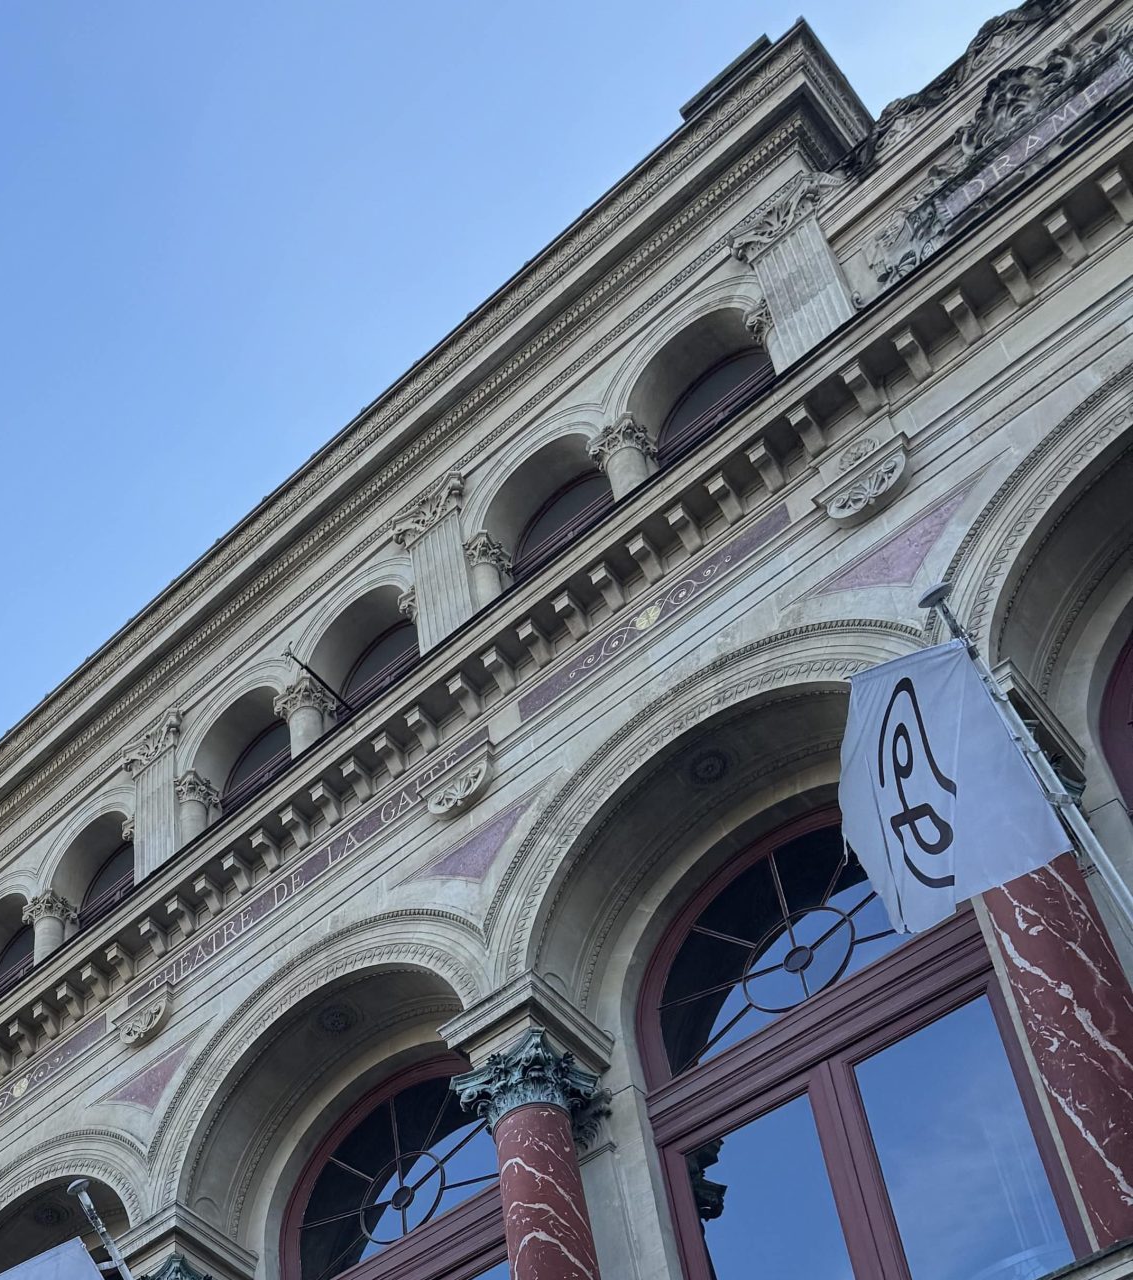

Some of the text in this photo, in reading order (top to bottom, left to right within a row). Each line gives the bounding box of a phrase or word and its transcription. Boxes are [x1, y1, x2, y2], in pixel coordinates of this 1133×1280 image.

[963, 80, 1106, 201] DRAME
[273, 868, 305, 907] DE
[327, 832, 360, 866] LA
